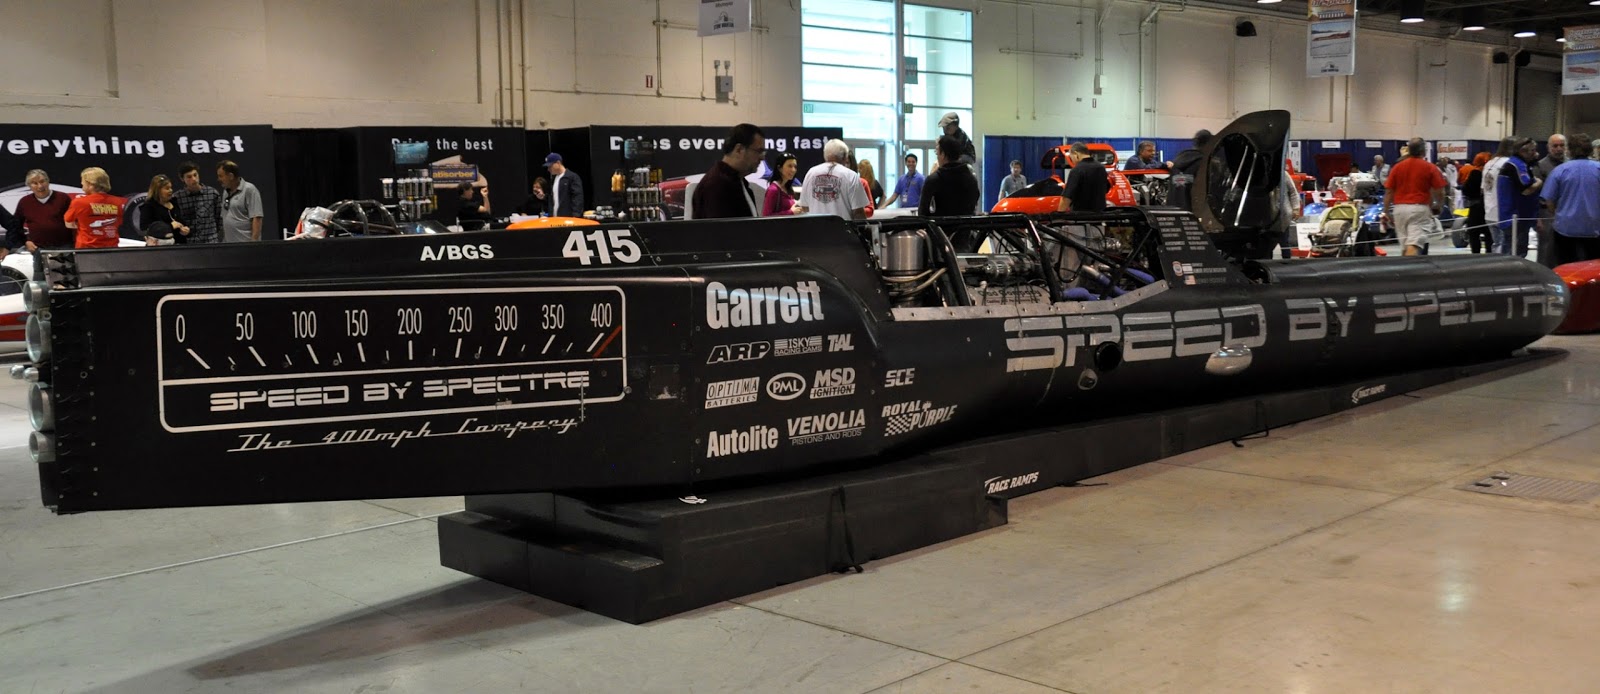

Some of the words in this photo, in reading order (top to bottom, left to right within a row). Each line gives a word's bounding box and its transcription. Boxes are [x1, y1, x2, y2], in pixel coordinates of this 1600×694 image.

[178, 136, 244, 154] fast
[436, 138, 458, 151] the
[465, 138, 493, 151] best
[679, 137, 788, 153] everng
[420, 243, 495, 262] A/BGS
[562, 228, 642, 266] 415
[706, 280, 825, 329] Garrett
[175, 314, 187, 343] 0
[235, 312, 254, 341] 50
[292, 310, 317, 339] 100
[345, 308, 370, 337] 150
[397, 307, 423, 335] 200
[448, 305, 473, 333] 250
[494, 304, 519, 332] 300
[541, 303, 565, 330] 350
[590, 302, 612, 328] 400
[1003, 303, 1267, 373] SPEED
[1284, 297, 1357, 341] BY
[1372, 284, 1564, 334] SPECTRE
[706, 340, 771, 365] ARP
[774, 348, 801, 357] RACING
[788, 336, 811, 349] ISKY
[707, 377, 760, 400] OPTIMA
[772, 379, 800, 393] PML
[813, 367, 856, 390] MSD
[884, 367, 916, 388] SCE
[210, 385, 350, 412] SPEED
[362, 381, 412, 402] BY
[423, 371, 590, 398] SPECTRE
[705, 394, 758, 408] BATTERIES
[811, 384, 856, 399] IGNITION
[881, 399, 921, 418] ROYAL
[909, 403, 958, 431] PURPLE
[787, 408, 866, 437] VENOLIA
[227, 432, 293, 453] The
[321, 421, 432, 449] 400mph
[457, 417, 579, 439] Company
[706, 424, 779, 459] Autolite
[791, 435, 824, 446] PISTONS
[825, 432, 842, 442] AND
[842, 430, 862, 439] RODS
[987, 478, 1011, 495] RACE
[1009, 471, 1040, 489] RAMPS
